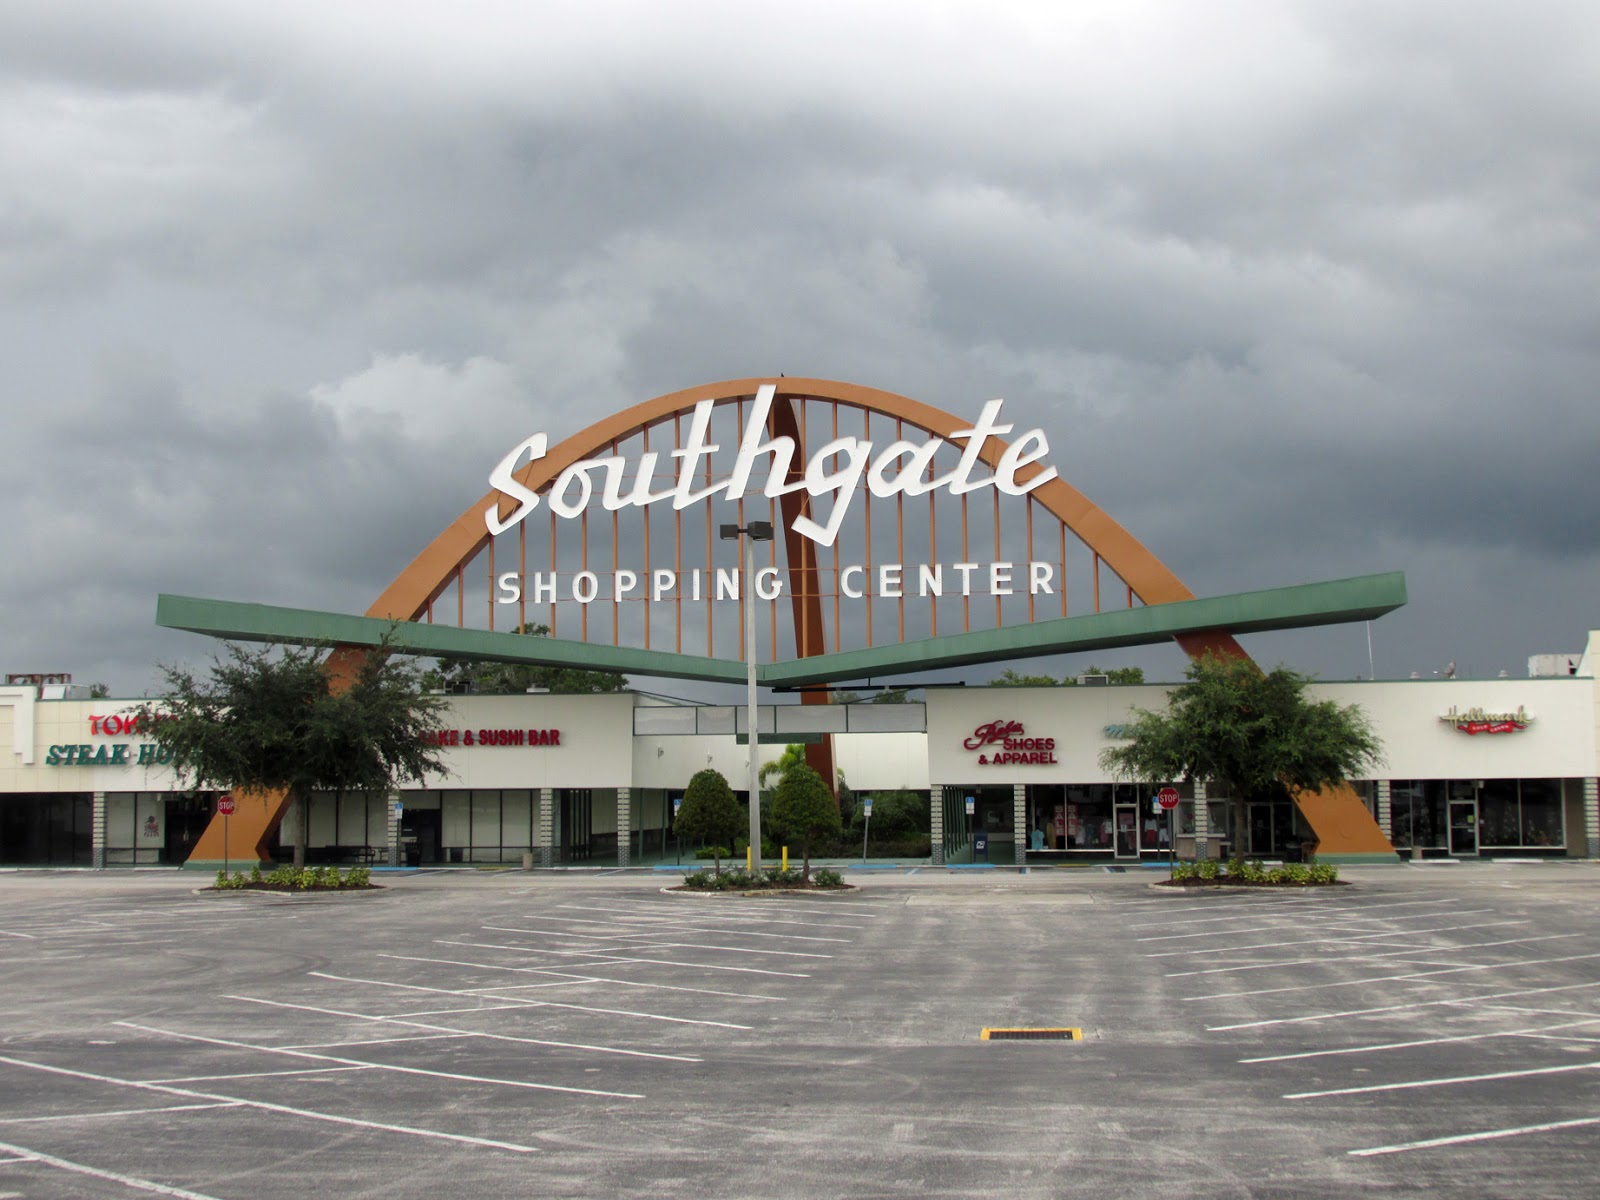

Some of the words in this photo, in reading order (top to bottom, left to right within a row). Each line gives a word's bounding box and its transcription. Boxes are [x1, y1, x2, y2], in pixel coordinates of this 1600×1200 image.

[485, 384, 1058, 547] Southgate
[498, 567, 783, 605] SHOPPING
[841, 561, 1054, 598] CENTER
[1439, 704, 1534, 732] Hallmark
[463, 730, 474, 745] &
[479, 730, 523, 746] SUSHI
[528, 730, 560, 746] BAR
[1003, 738, 1055, 751] SHOES
[46, 744, 130, 766] STEAK
[978, 754, 988, 765] &
[992, 752, 1058, 765] APPAREL
[219, 801, 235, 810] STOP
[1159, 794, 1178, 803] STOP
